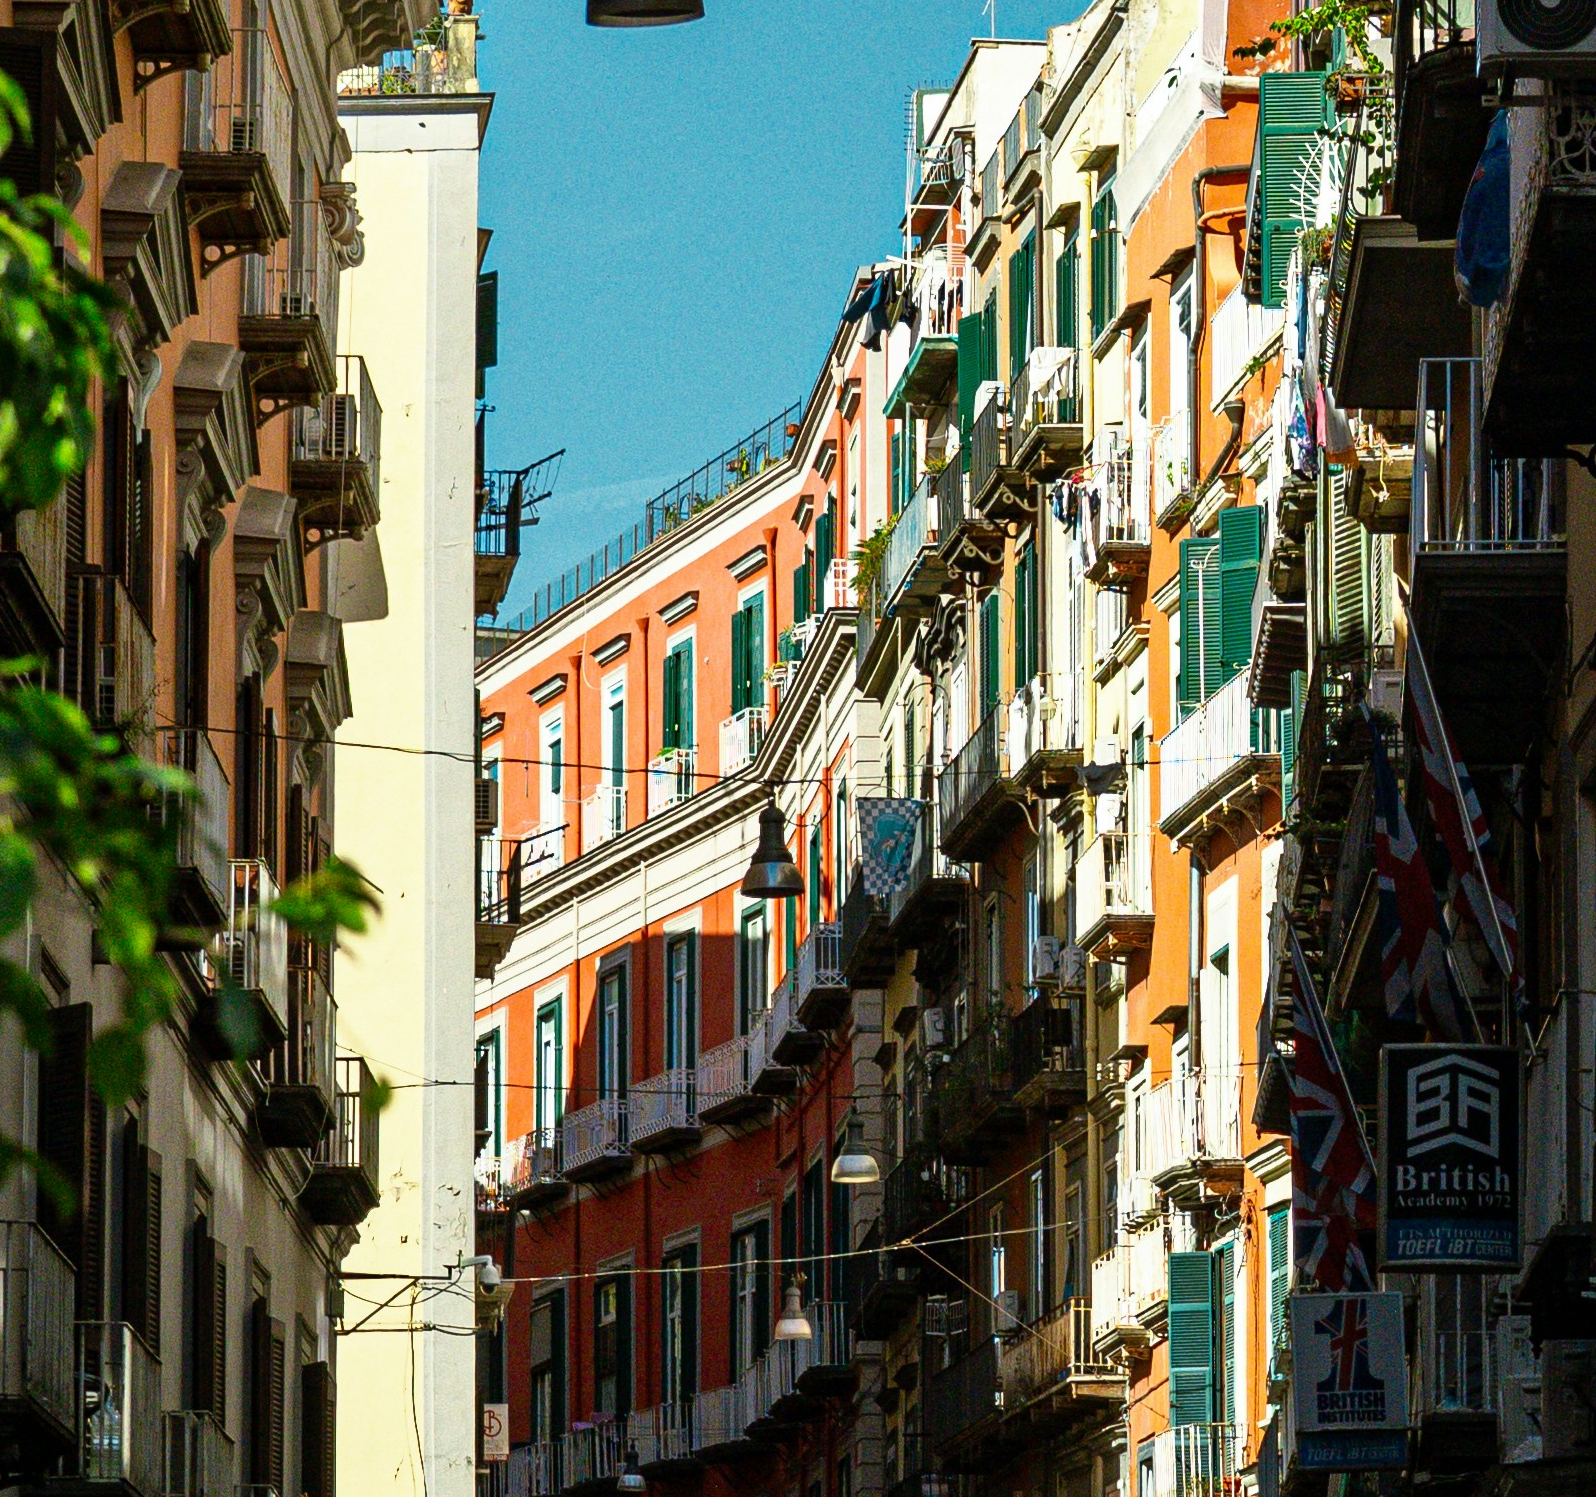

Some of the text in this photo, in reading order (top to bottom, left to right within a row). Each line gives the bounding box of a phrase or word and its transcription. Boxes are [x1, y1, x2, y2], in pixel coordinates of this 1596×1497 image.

[1395, 1163, 1511, 1193] British
[1395, 1193, 1512, 1210] Academy 1972
[1397, 1239, 1443, 1255] TOEFL
[1447, 1238, 1475, 1255] iBT
[1317, 1391, 1386, 1411] BRITISH
[1317, 1410, 1387, 1424] INSTITUTES
